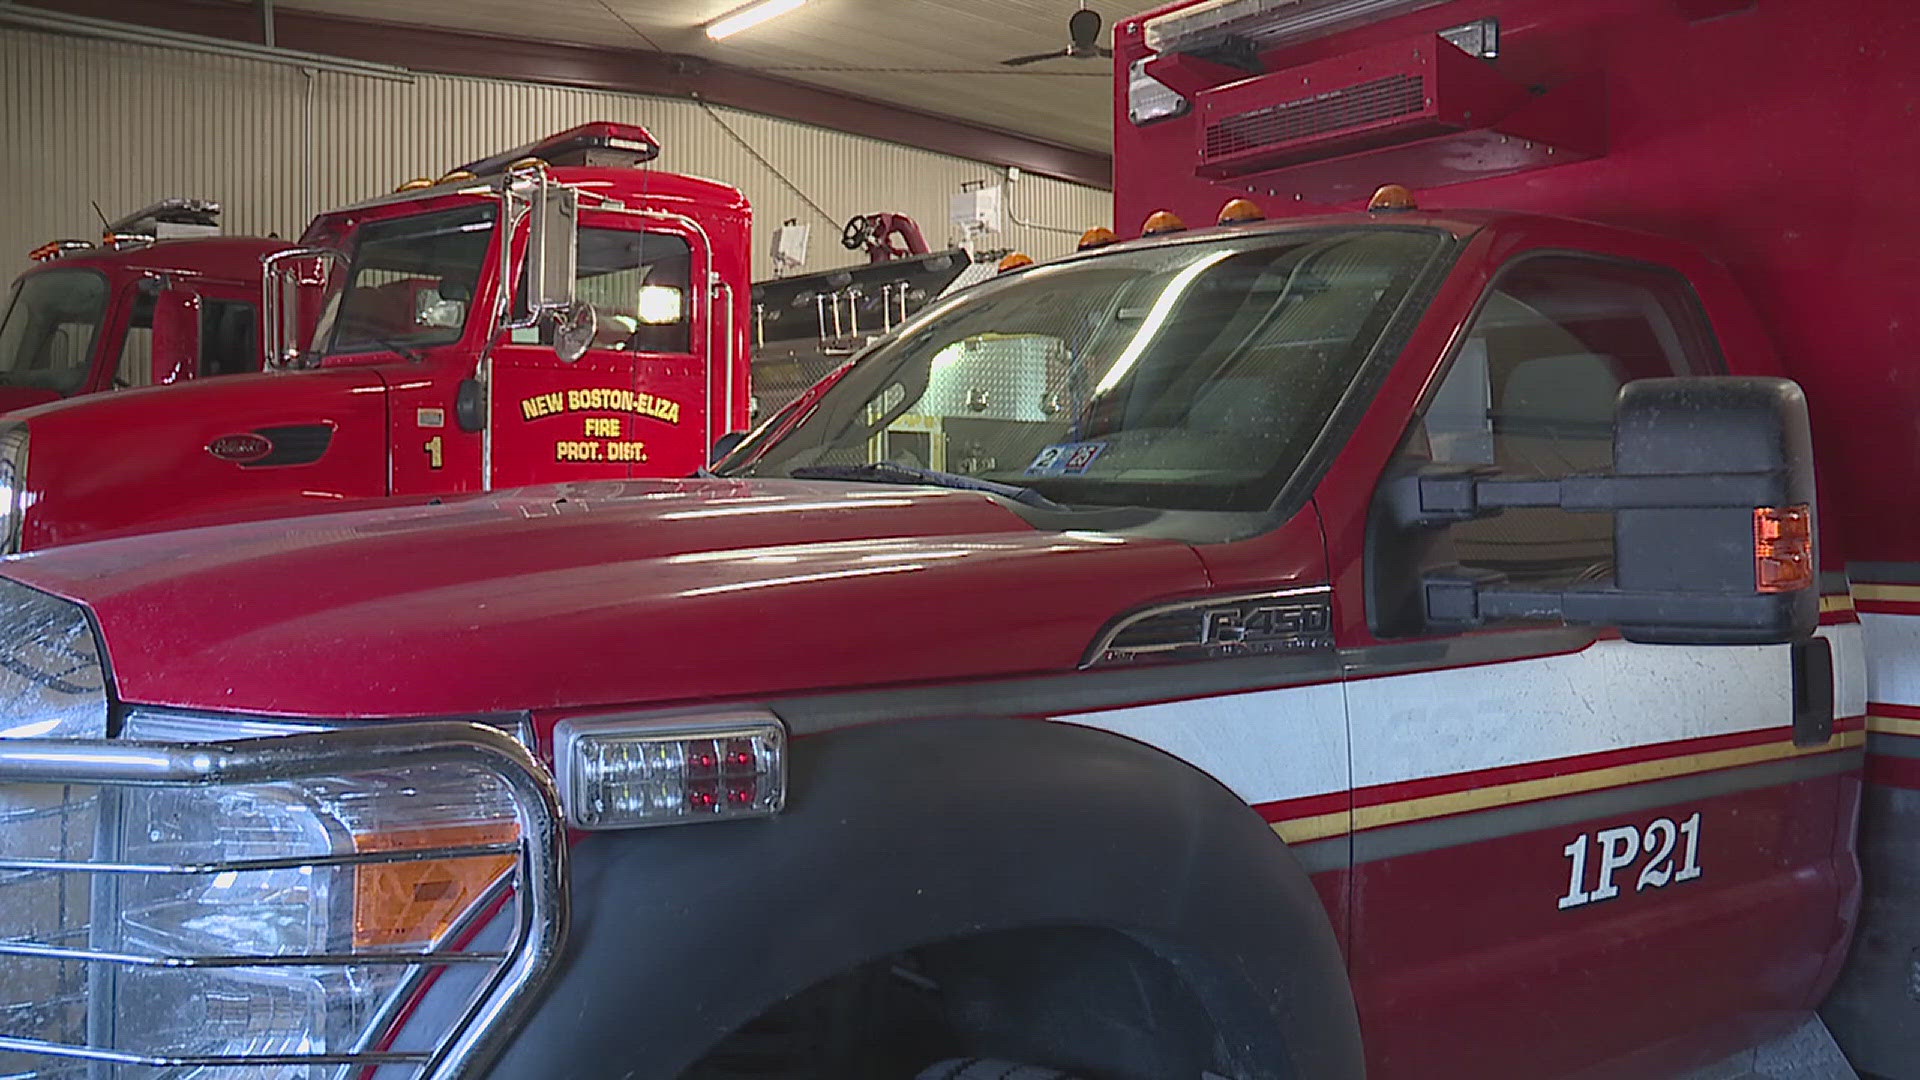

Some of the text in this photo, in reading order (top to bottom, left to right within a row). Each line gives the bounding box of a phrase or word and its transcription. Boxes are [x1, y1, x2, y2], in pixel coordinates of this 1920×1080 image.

[521, 391, 564, 420] NEW
[584, 417, 621, 437] FIRE
[424, 435, 443, 469] 1
[556, 441, 648, 462] PROT. DIST.
[1557, 811, 1702, 911] 1P21
